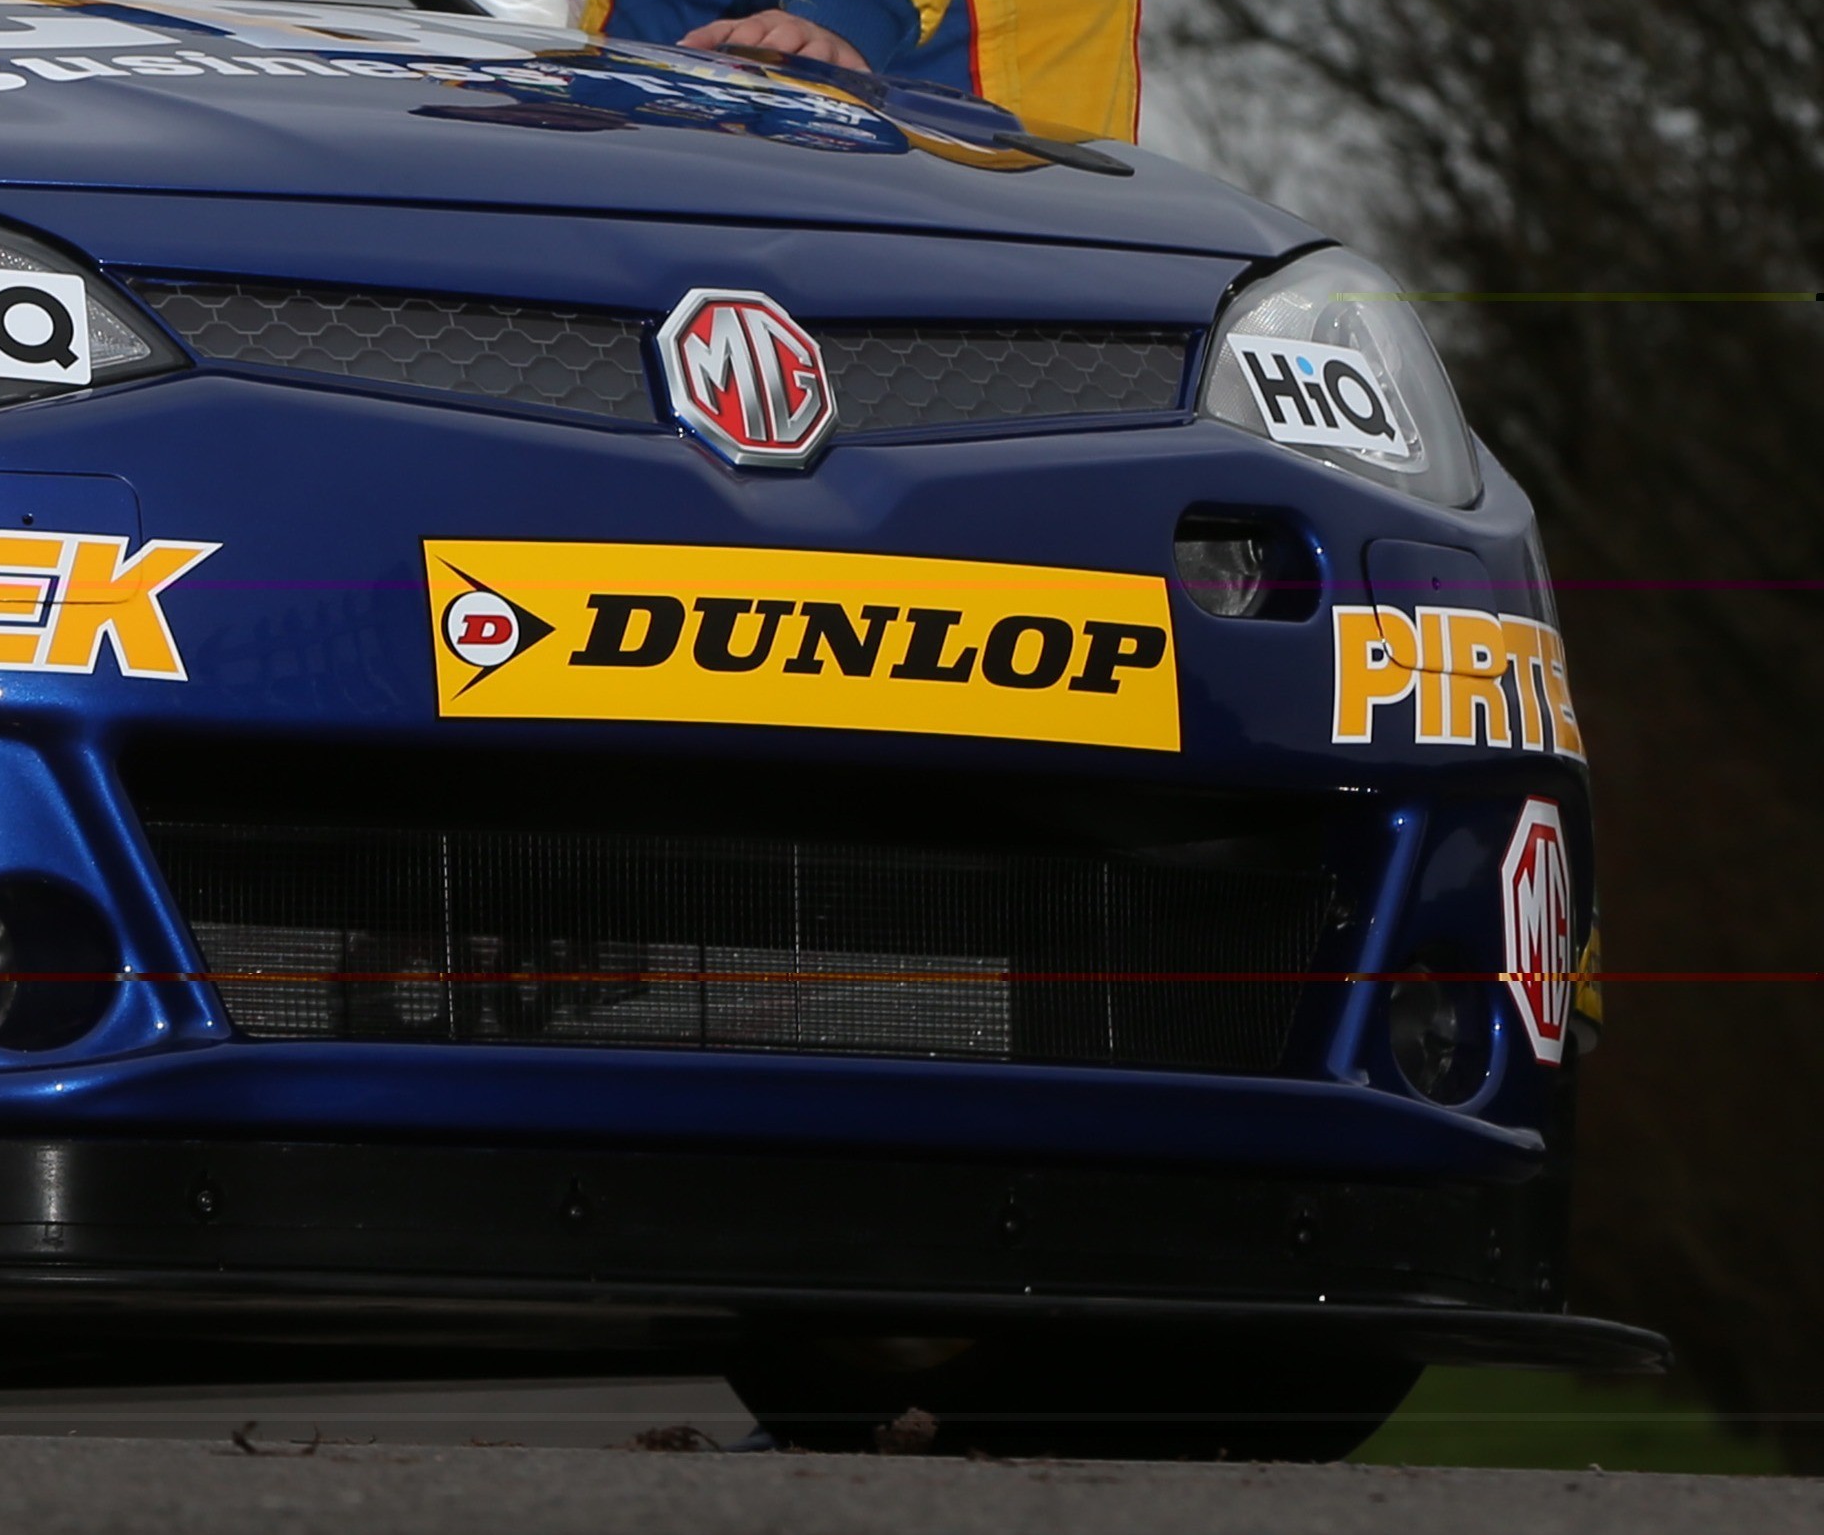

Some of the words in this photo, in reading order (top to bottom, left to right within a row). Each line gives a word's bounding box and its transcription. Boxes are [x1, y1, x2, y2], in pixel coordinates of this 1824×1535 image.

[680, 305, 821, 444] MG
[1242, 350, 1397, 443] HiQ
[567, 592, 1168, 695] DUNLOP
[1331, 604, 1588, 765] PIRTE
[1517, 836, 1568, 1028] MG
